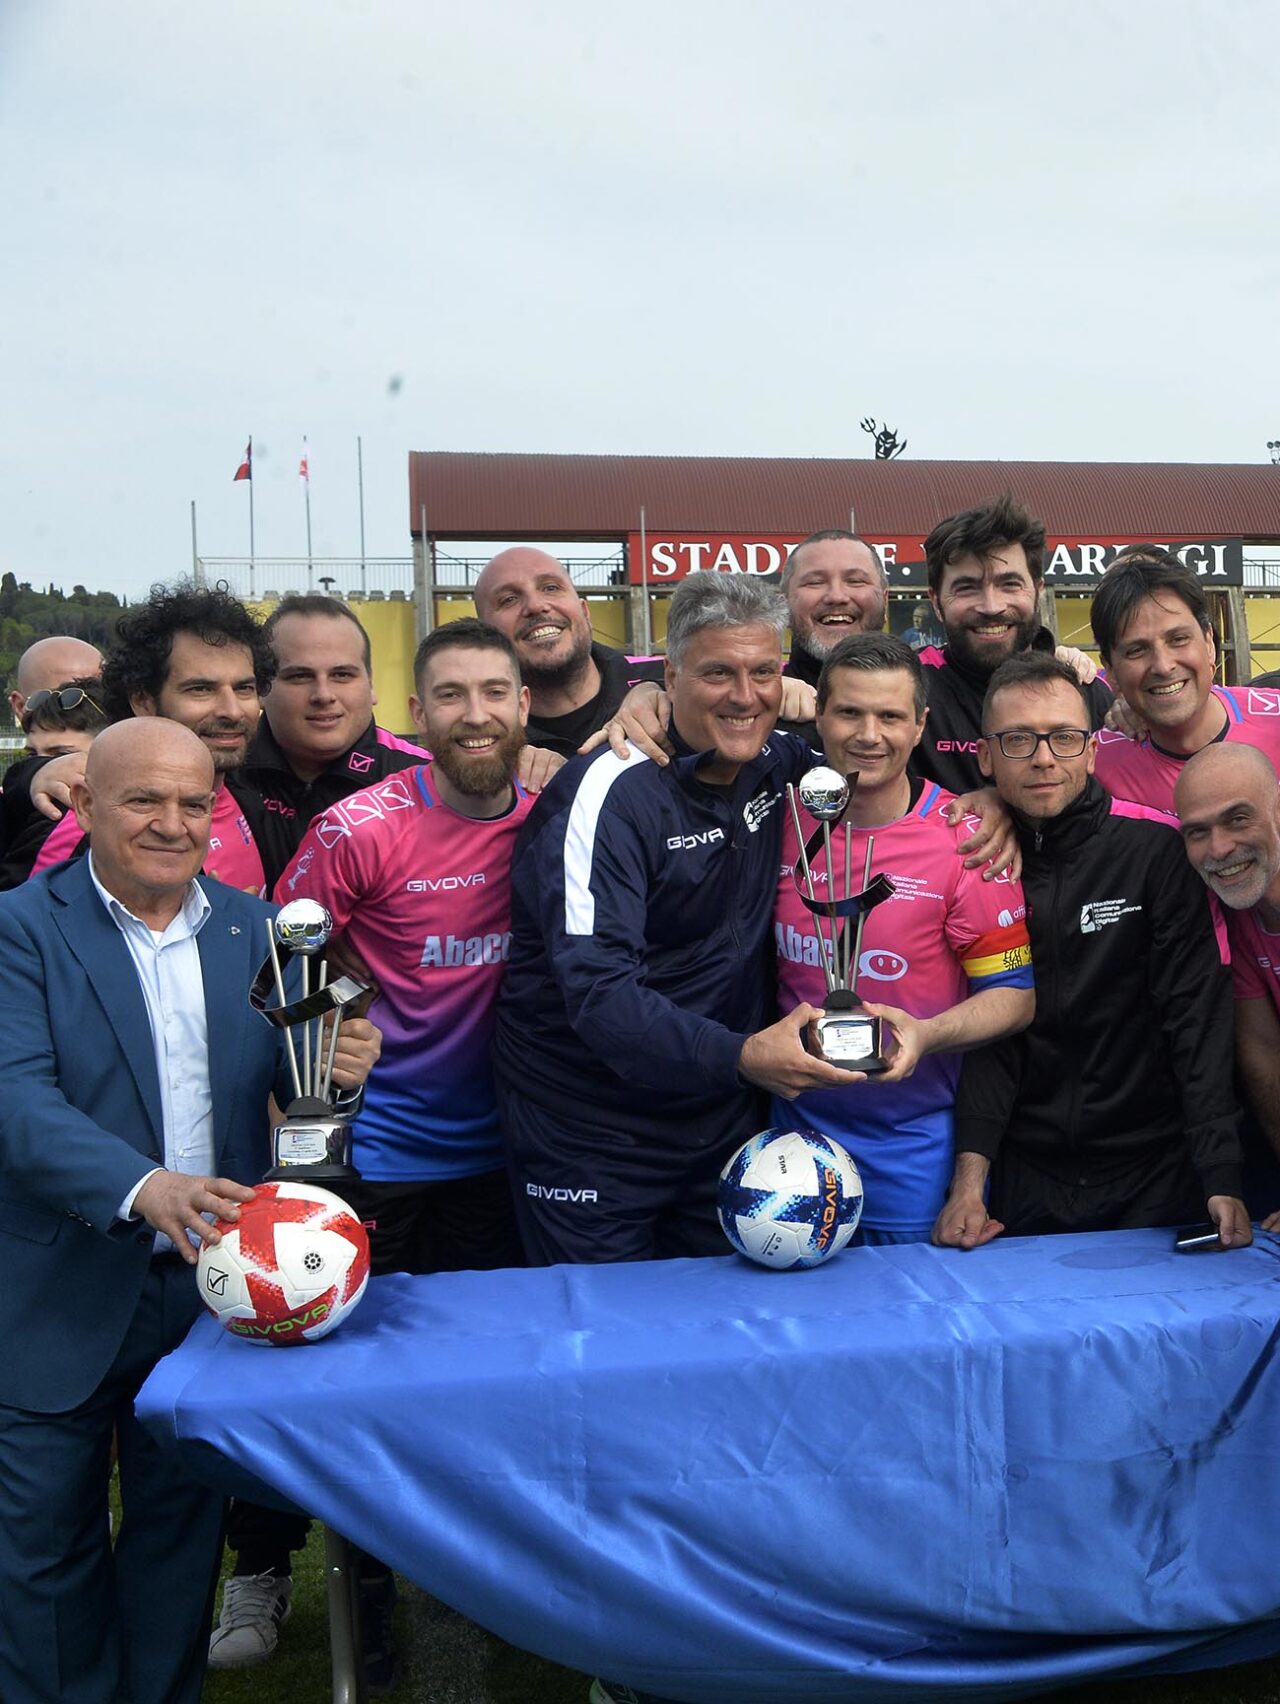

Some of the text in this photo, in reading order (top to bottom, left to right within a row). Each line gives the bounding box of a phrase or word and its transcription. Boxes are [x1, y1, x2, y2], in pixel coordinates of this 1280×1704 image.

[406, 873, 486, 892] GIVOVA
[778, 1154, 787, 1175] STAR
[526, 1183, 598, 1203] GIVOVA
[817, 1167, 837, 1249] GIVOVA
[232, 1303, 329, 1335] GIVOVA
